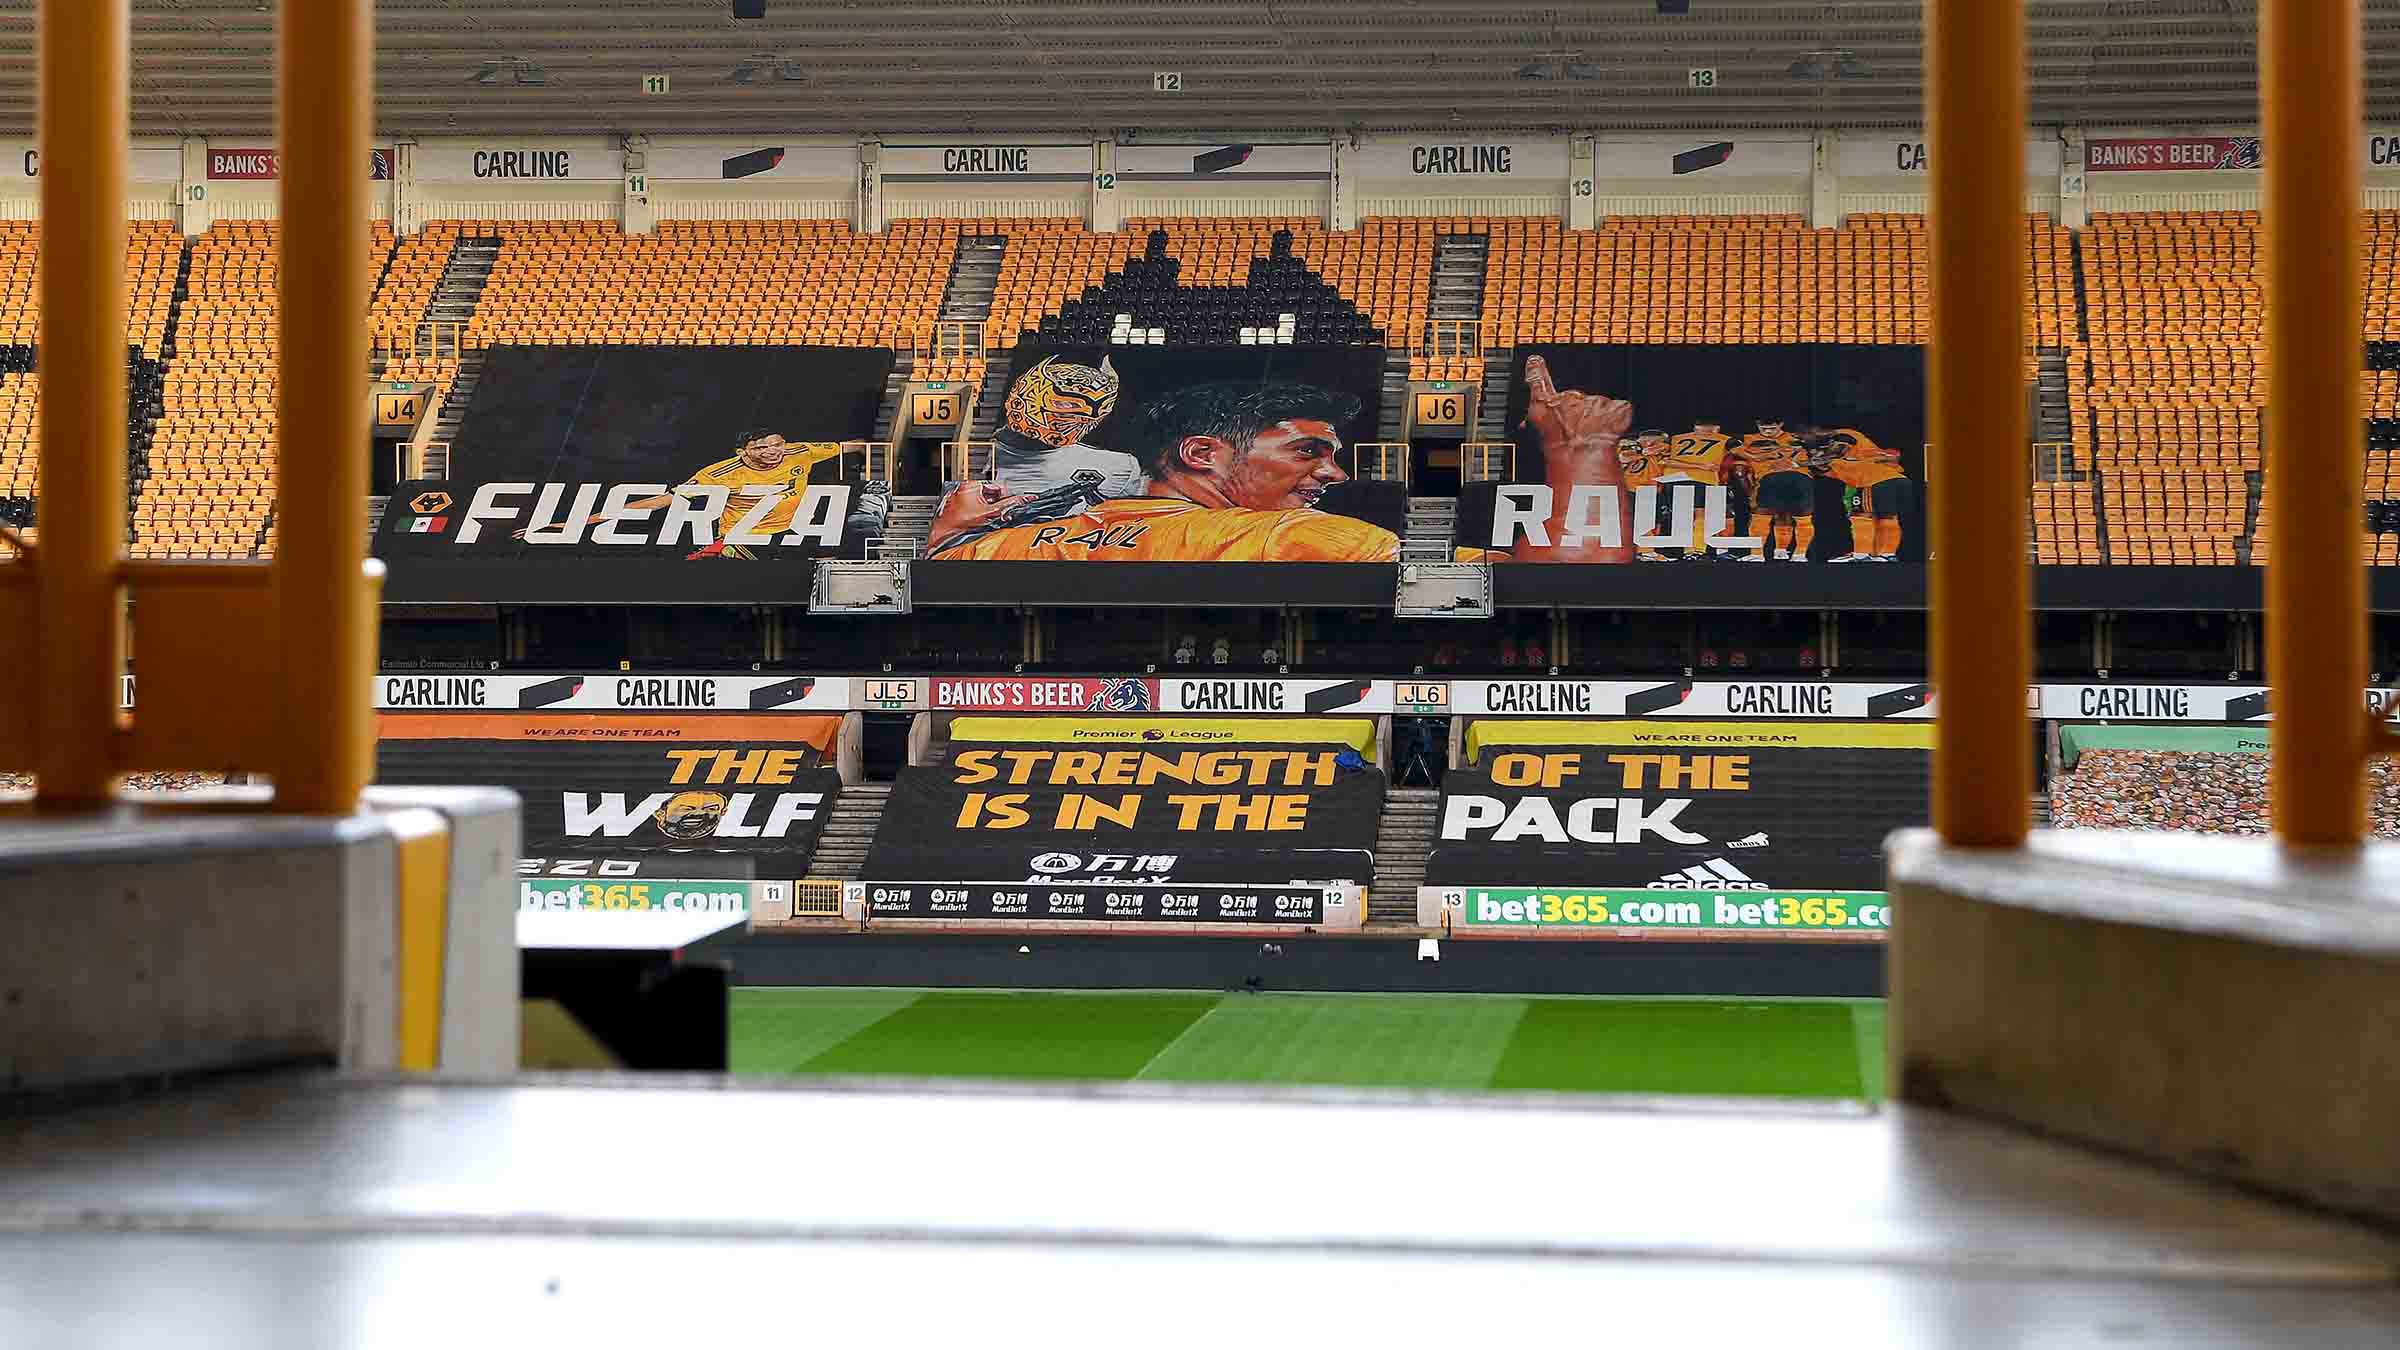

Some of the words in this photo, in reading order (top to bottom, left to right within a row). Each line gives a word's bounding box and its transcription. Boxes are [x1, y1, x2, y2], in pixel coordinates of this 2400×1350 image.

[647, 76, 665, 93] 11
[1156, 73, 1179, 89] 12
[1691, 70, 1713, 87] 13
[943, 147, 1029, 173] CARLING
[1411, 145, 1511, 174] CARLING
[2169, 143, 2215, 163] BEER
[473, 150, 569, 178] CARLING
[628, 175, 646, 193] 11
[1096, 173, 1115, 189] 12
[1572, 179, 1592, 196] 13
[185, 184, 206, 201] 10
[387, 400, 415, 420] J4
[922, 399, 950, 420] J5
[1427, 398, 1456, 420] J6
[1677, 439, 1720, 456] 27
[455, 482, 851, 546] FUERZA
[387, 678, 485, 706] CARLING
[616, 678, 716, 707] CARLING
[873, 681, 907, 700] JL5
[1031, 683, 1084, 706] BEER
[1182, 682, 1285, 711] CARLING
[1404, 685, 1440, 703] JL6
[1487, 683, 1590, 712] CARLING
[1727, 684, 1832, 715] CARLING
[2080, 687, 2189, 718] CARLING
[524, 728, 551, 737] WE
[554, 728, 588, 737] ARE
[592, 728, 628, 737] ONE
[632, 728, 681, 737] TEAM
[1073, 729, 1136, 738] Premier
[1170, 729, 1233, 740] League
[1633, 734, 1662, 742] WE
[1666, 734, 1702, 742] ARE
[1705, 734, 1743, 742] ONE
[1745, 734, 1797, 742] TEAM
[666, 749, 805, 785] THE
[952, 750, 1337, 786] STRENGTH
[1490, 752, 1581, 788] OF
[1608, 754, 1750, 790] THE
[955, 793, 1031, 830] IS
[1054, 793, 1142, 830] IN
[1167, 794, 1310, 831] THE
[1440, 794, 1710, 846] PACK
[520, 882, 744, 912] bet365.com
[767, 887, 779, 900] 11
[848, 887, 863, 900] 12
[1325, 892, 1342, 905] 12
[1443, 893, 1461, 906] 13
[1477, 893, 1701, 925] bet365.com
[1715, 897, 1889, 926] bet365.c
